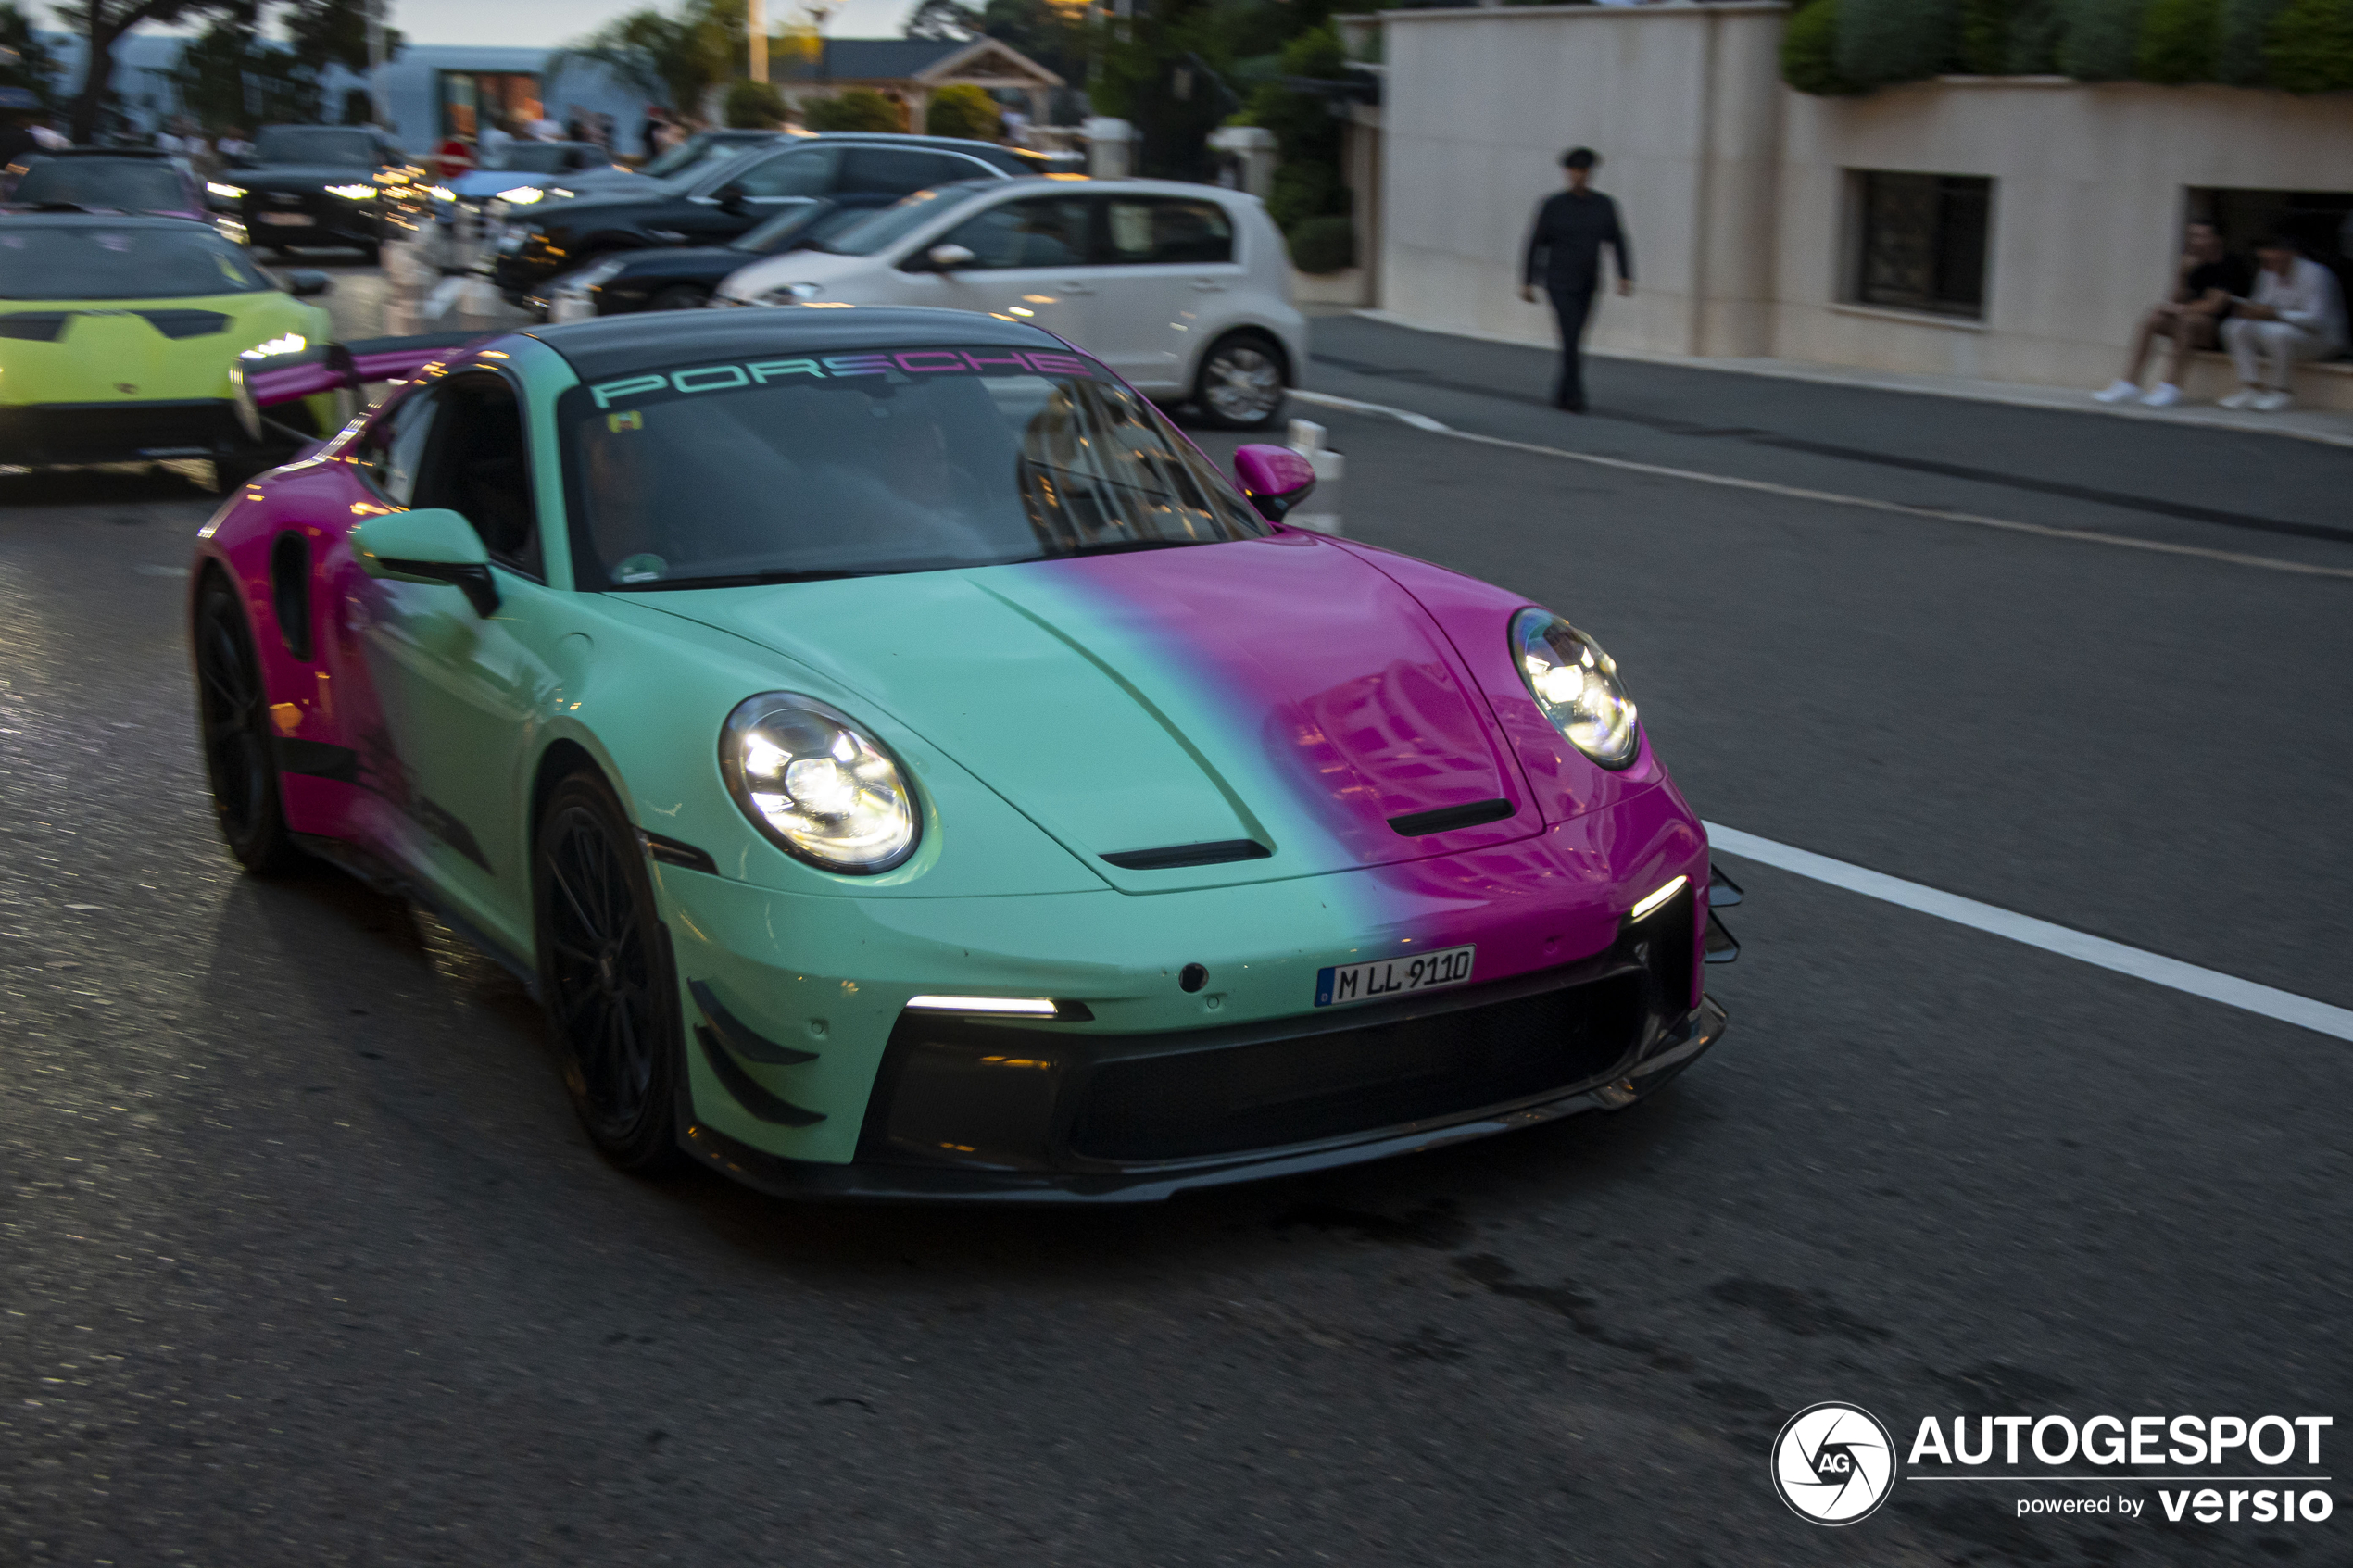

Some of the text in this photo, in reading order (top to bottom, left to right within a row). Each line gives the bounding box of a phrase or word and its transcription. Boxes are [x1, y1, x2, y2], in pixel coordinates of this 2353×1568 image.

[589, 351, 1092, 408] PORSCHE
[1339, 951, 1470, 999] M LL 9110
